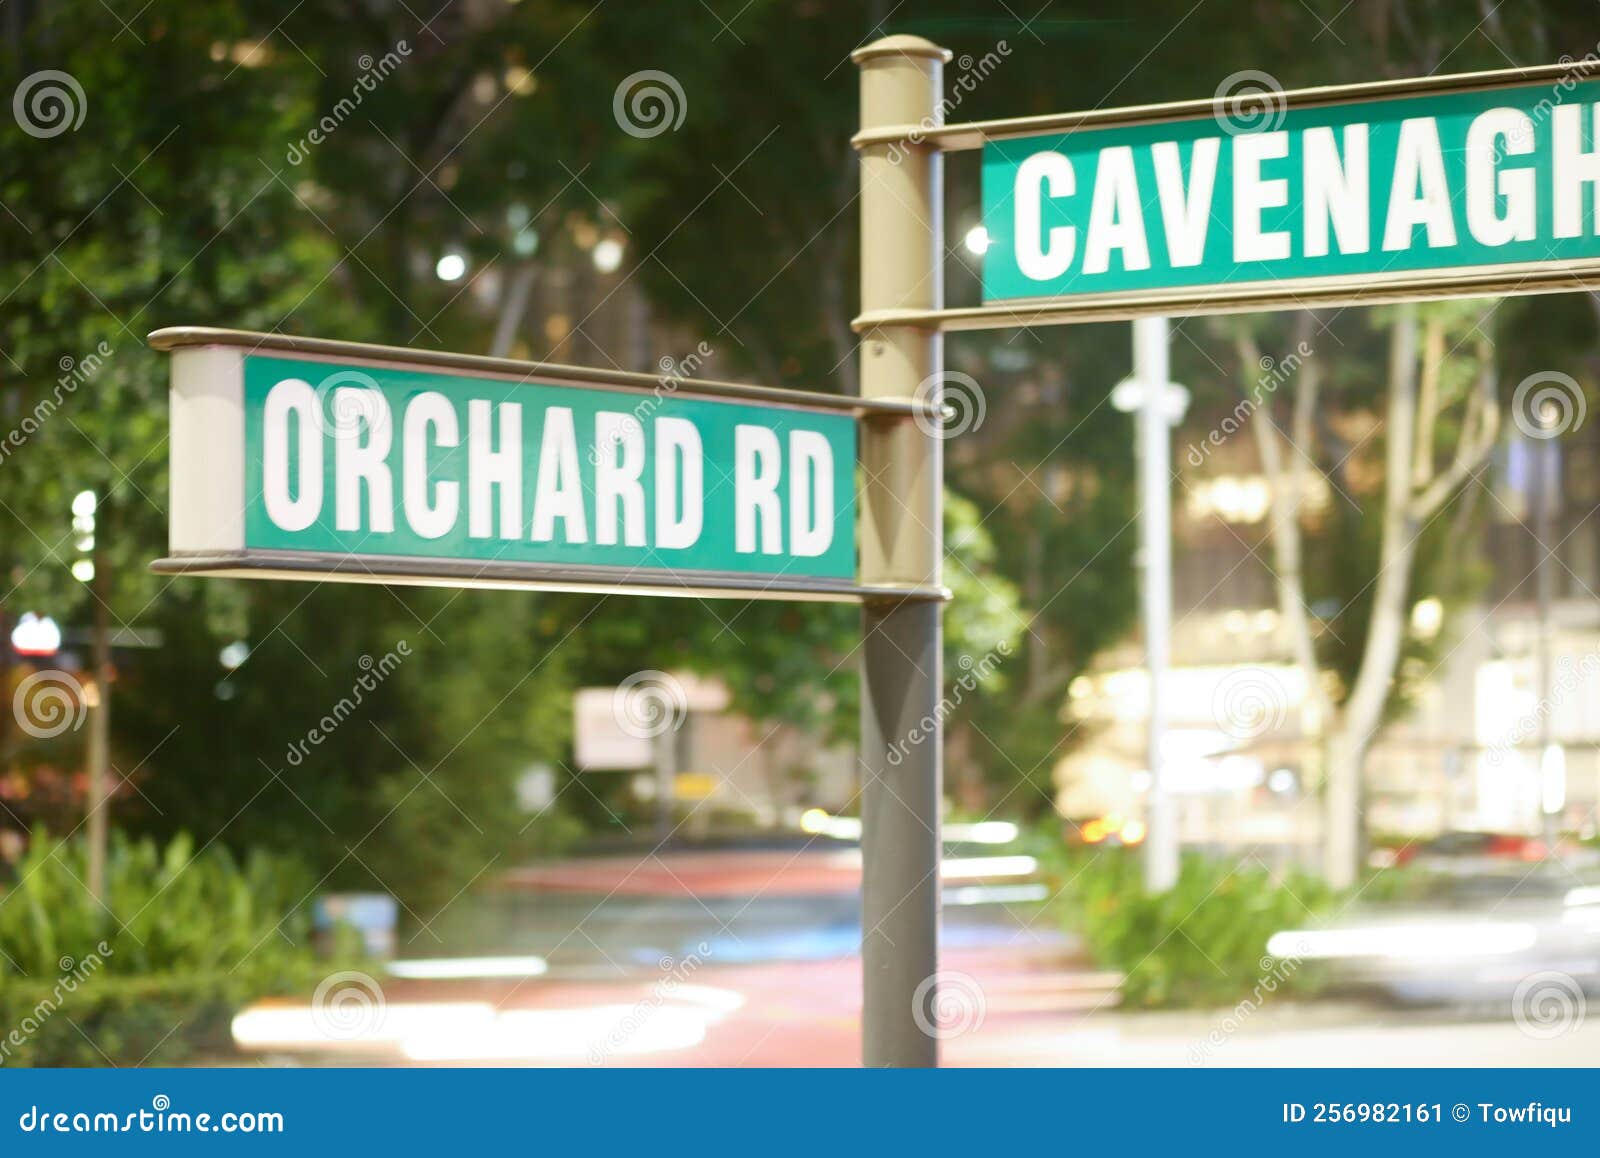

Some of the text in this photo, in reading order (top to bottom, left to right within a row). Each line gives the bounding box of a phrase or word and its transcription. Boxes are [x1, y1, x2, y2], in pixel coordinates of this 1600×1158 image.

[1013, 102, 1600, 282] CAVENAGH
[263, 377, 834, 557] ORCHARD RD
